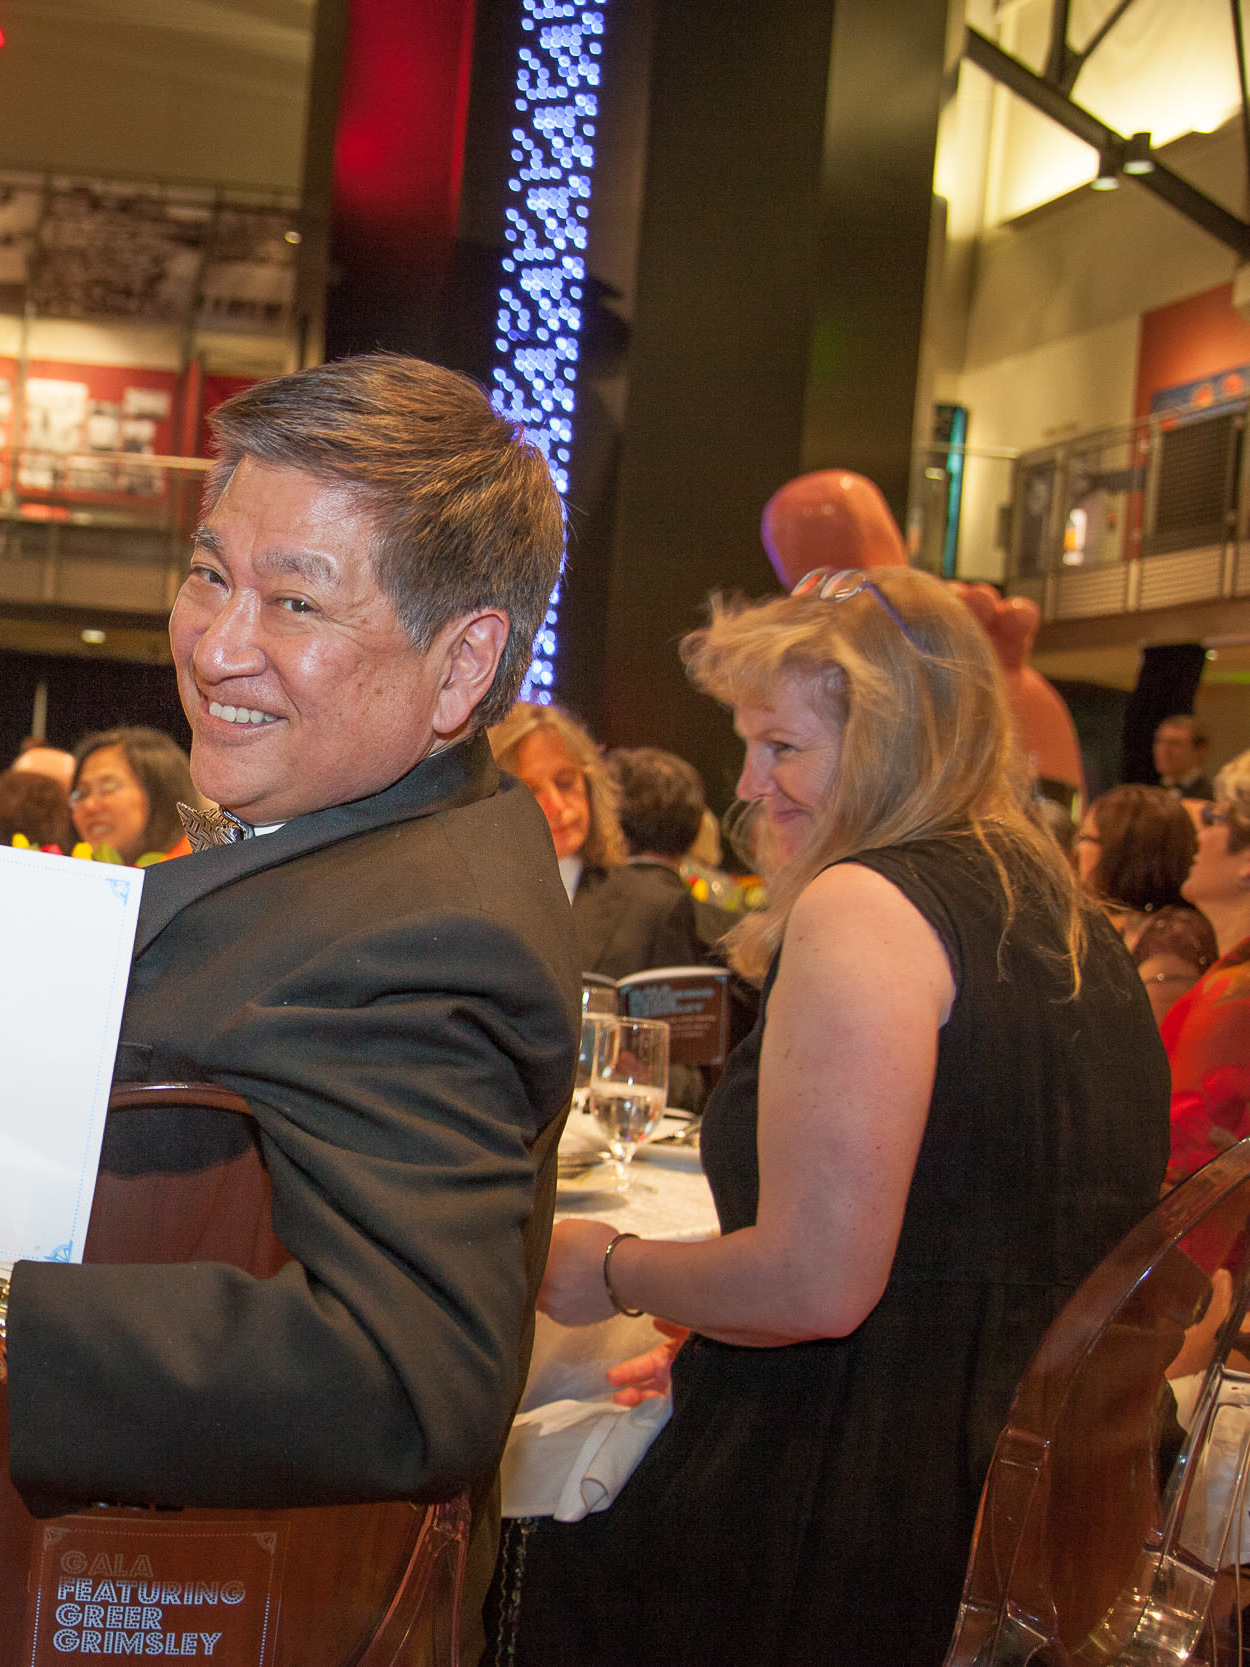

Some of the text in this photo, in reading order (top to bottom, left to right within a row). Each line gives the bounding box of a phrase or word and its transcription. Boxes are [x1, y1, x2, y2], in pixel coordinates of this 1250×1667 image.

[60, 1549, 155, 1578] GALA
[57, 1575, 247, 1606] FEATURING
[55, 1602, 164, 1630] GREER
[52, 1628, 223, 1656] GRIMSLEY
